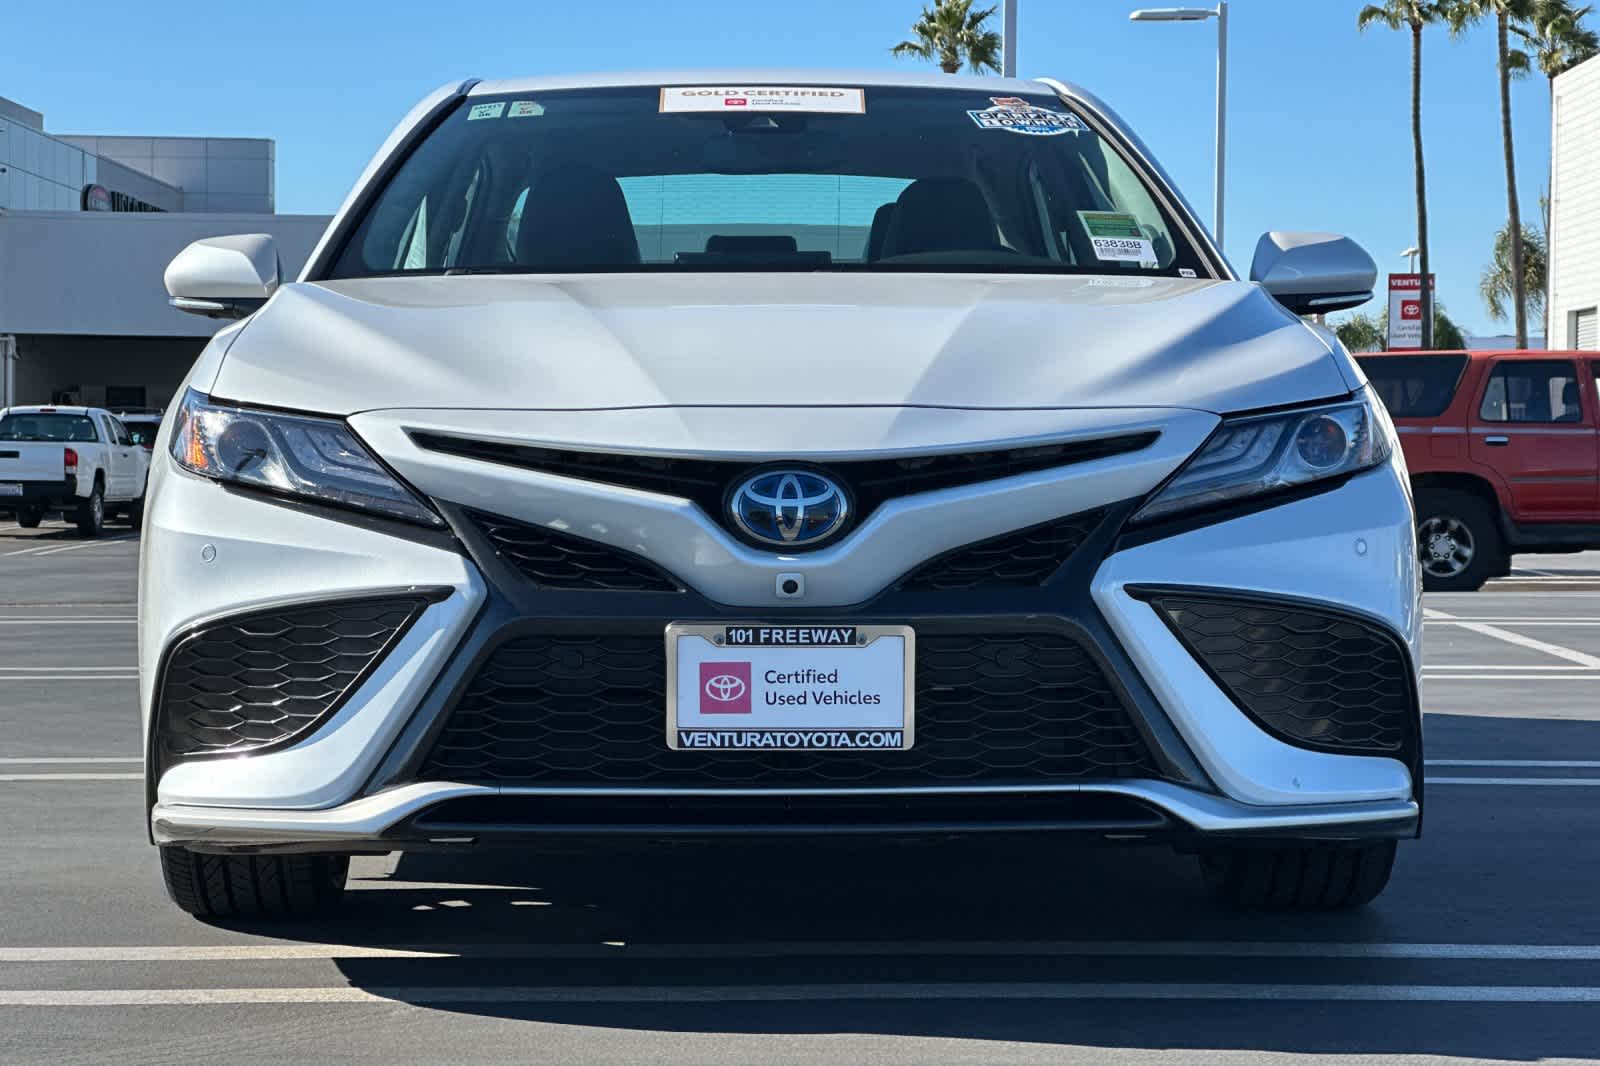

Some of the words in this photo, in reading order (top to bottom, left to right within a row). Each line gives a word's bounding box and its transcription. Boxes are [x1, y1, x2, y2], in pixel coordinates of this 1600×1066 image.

[681, 89, 739, 97] GOLD
[743, 89, 845, 98] CERTIFIED
[1094, 239, 1142, 249] 63838B
[728, 629, 754, 643] 101
[760, 629, 853, 643] FREEWAY
[764, 668, 838, 684] Certified
[765, 690, 807, 705] Used
[812, 690, 881, 705] Vehicles
[680, 732, 902, 748] VENTURATOYOTA.COM
